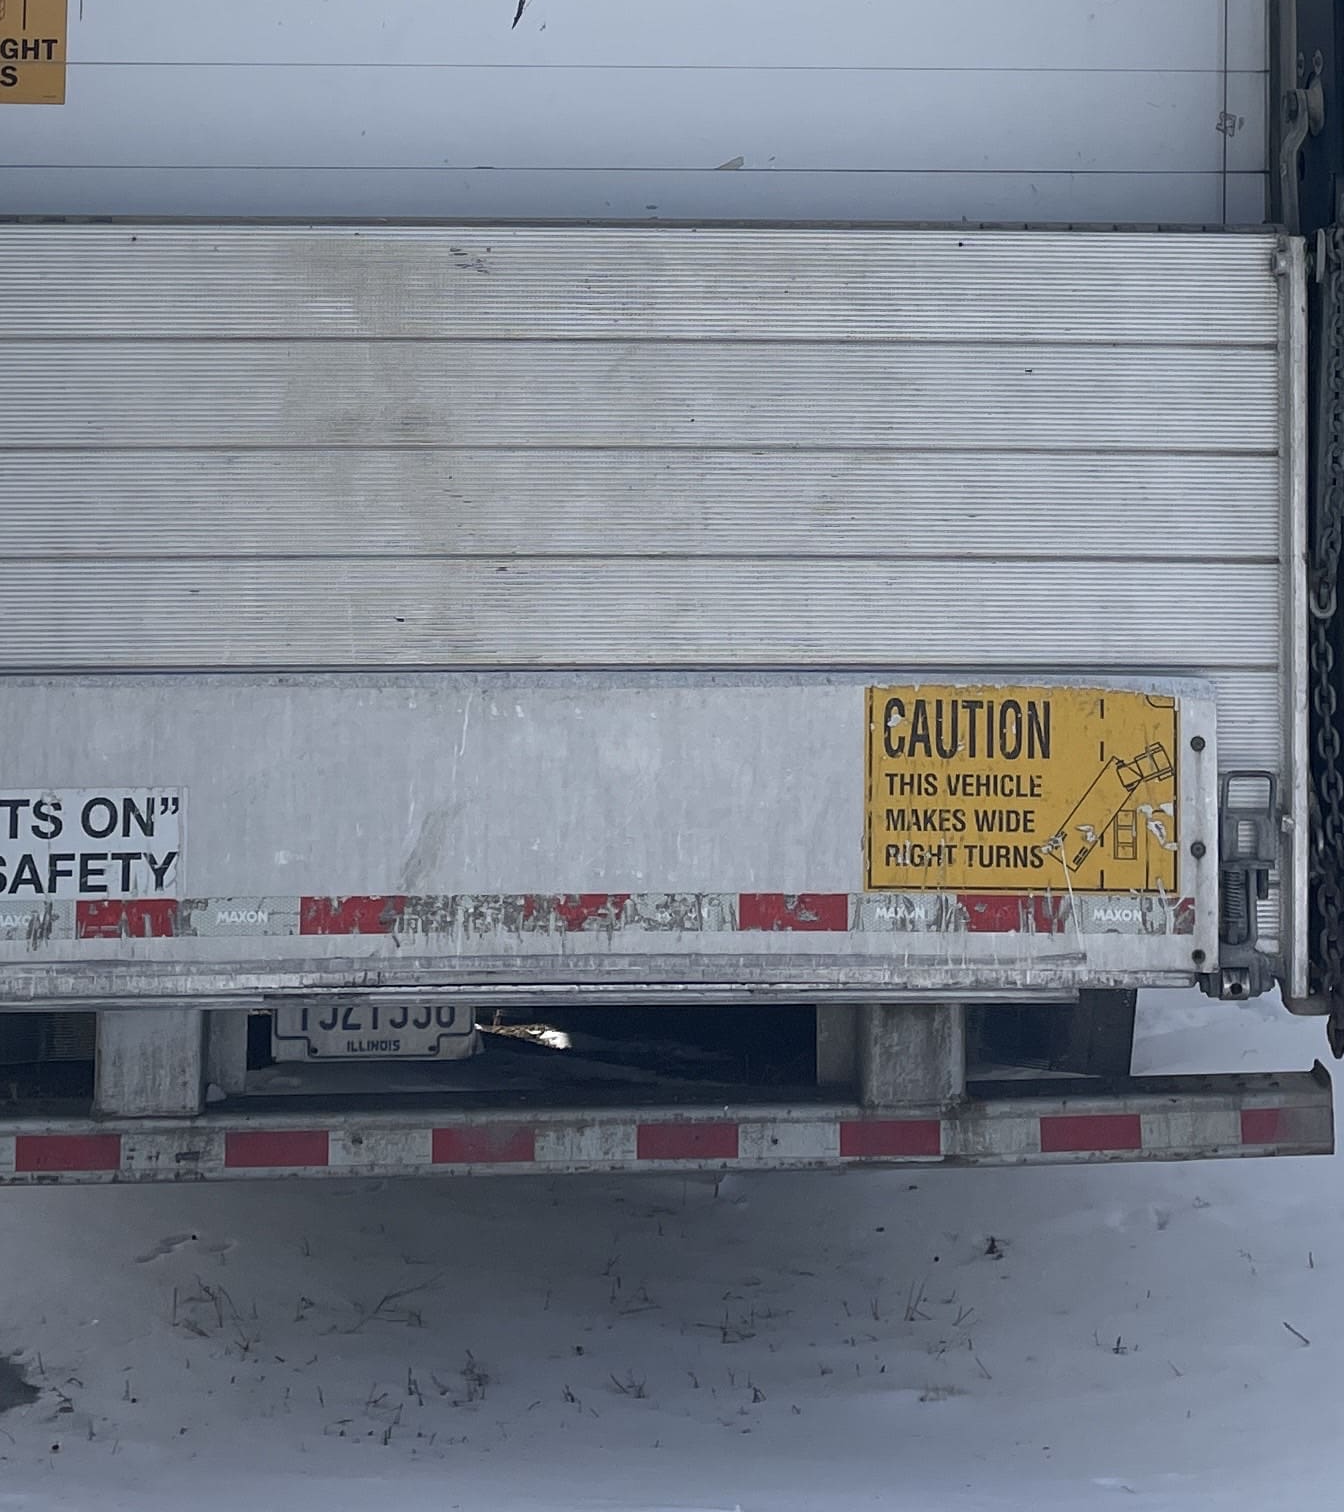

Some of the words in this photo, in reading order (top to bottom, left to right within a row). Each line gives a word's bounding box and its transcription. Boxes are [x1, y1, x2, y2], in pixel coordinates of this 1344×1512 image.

[883, 697, 1051, 760] CAUTION
[884, 773, 938, 796] THIS
[947, 774, 1043, 797] VEHICLE
[885, 808, 966, 832] MAKES
[974, 809, 1036, 832] WIDE
[885, 844, 957, 868] RIGHT
[963, 844, 1044, 869] TURNS
[216, 910, 269, 924] MAXON
[1091, 908, 1143, 922] MAXON
[346, 1040, 401, 1053] ILLINOIS
